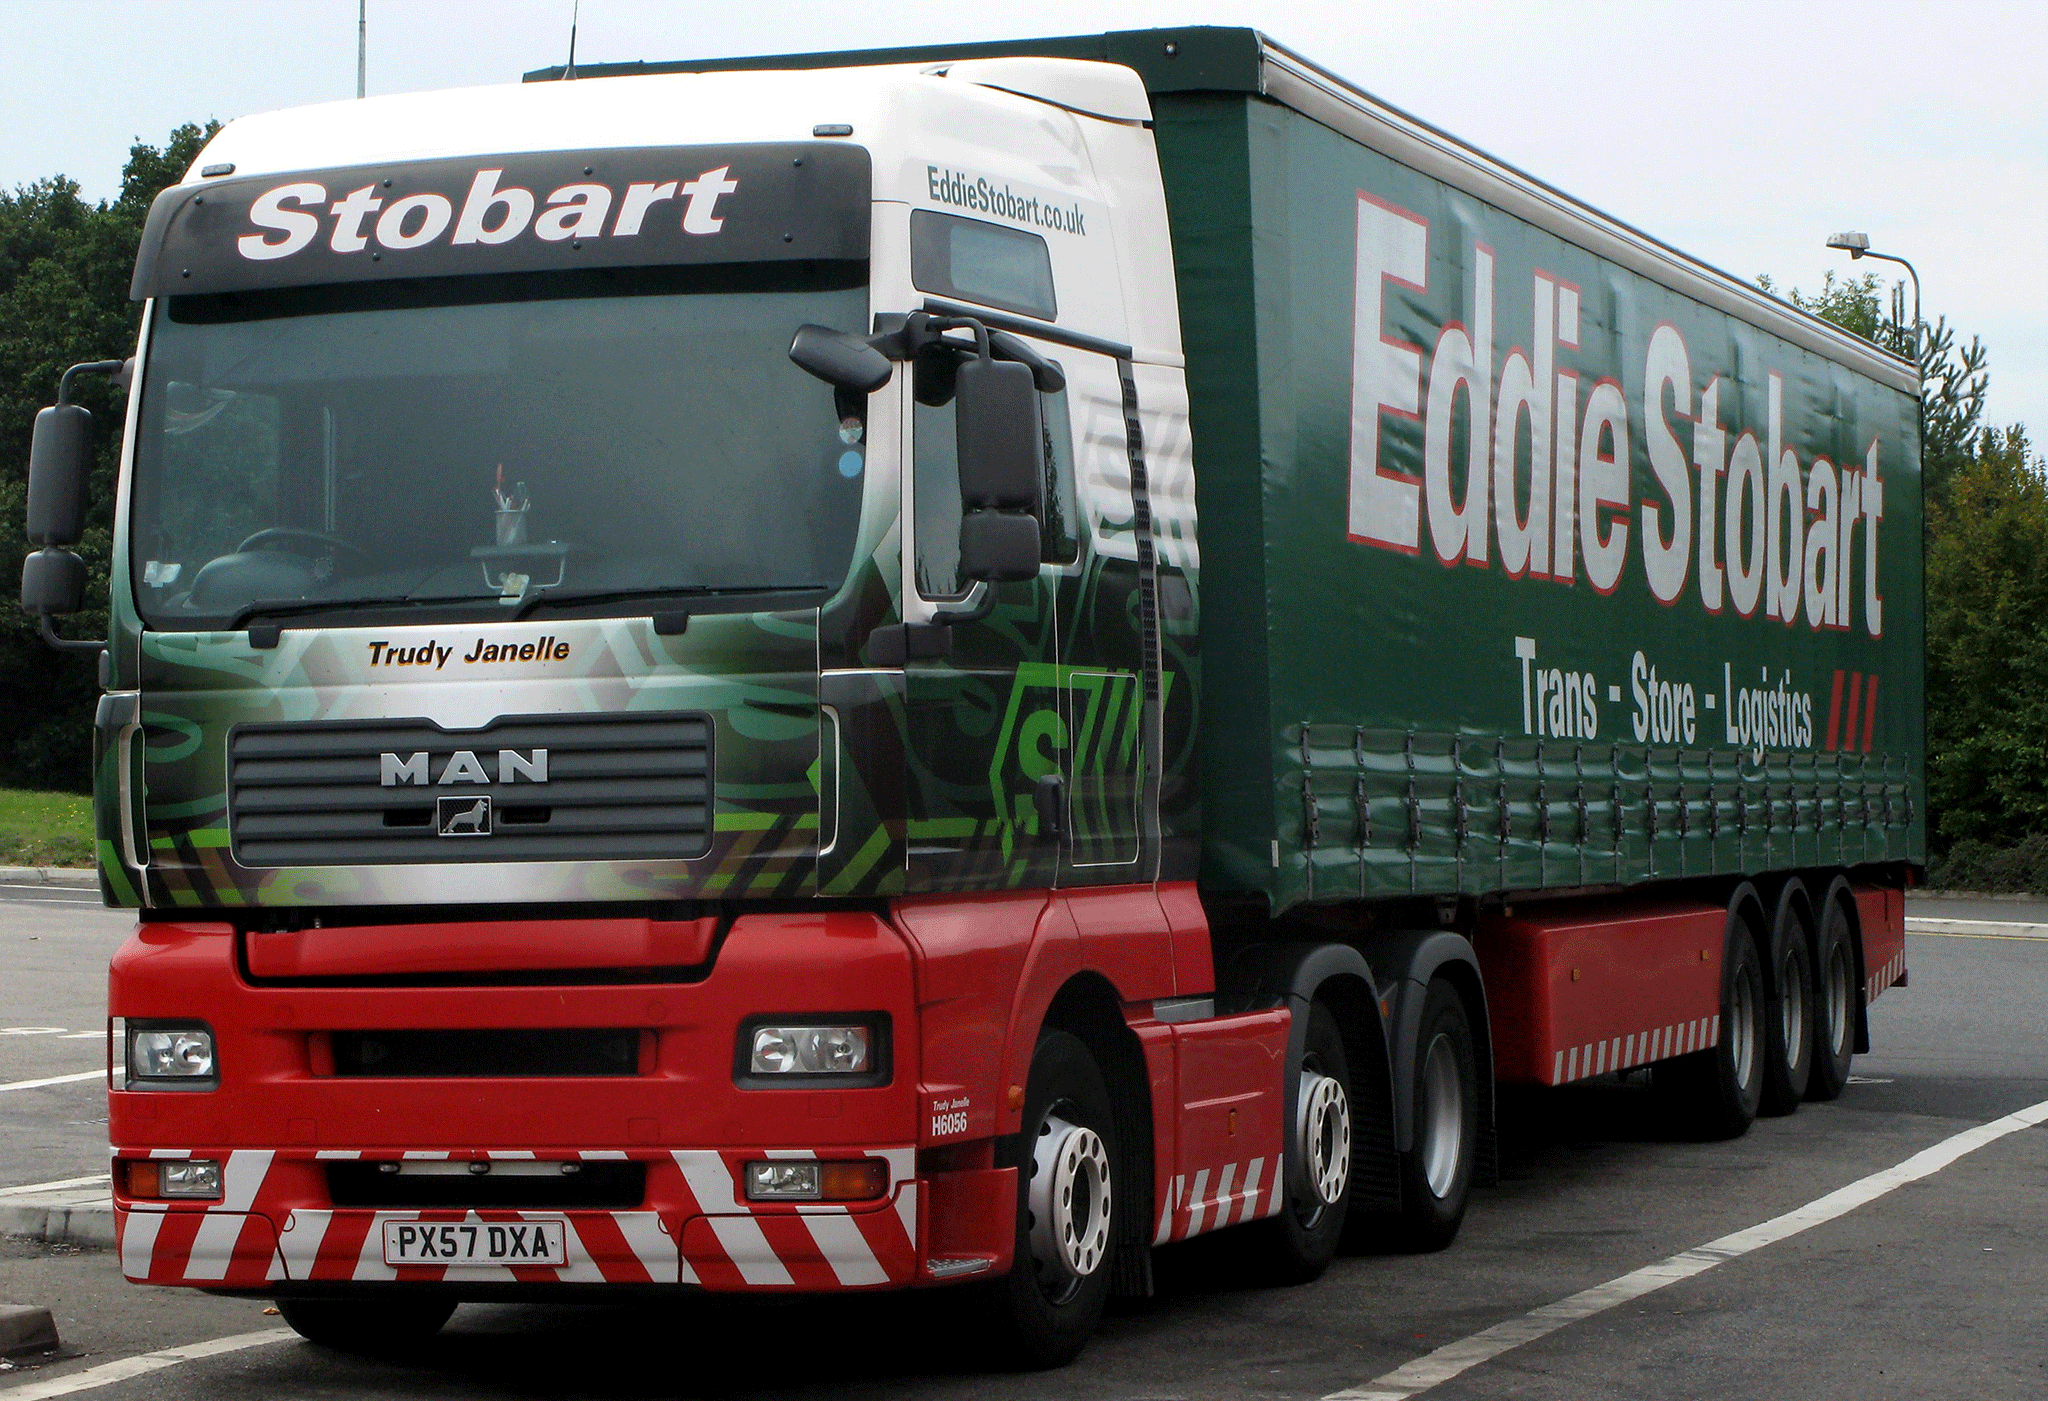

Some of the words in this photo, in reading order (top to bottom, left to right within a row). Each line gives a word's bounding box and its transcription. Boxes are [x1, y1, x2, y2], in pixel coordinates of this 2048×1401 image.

[237, 166, 738, 261] Stobart
[927, 165, 1087, 237] EddieStobart.co.uk
[368, 640, 453, 670] Trudy
[464, 636, 570, 664] Janelle
[1515, 636, 1597, 740] Trans
[1631, 650, 1696, 745] Store
[1724, 662, 1813, 767] Logistics
[379, 748, 549, 787] MAN
[932, 1111, 967, 1137] H6056
[398, 1226, 477, 1258] PX57
[487, 1226, 550, 1258] DXA
